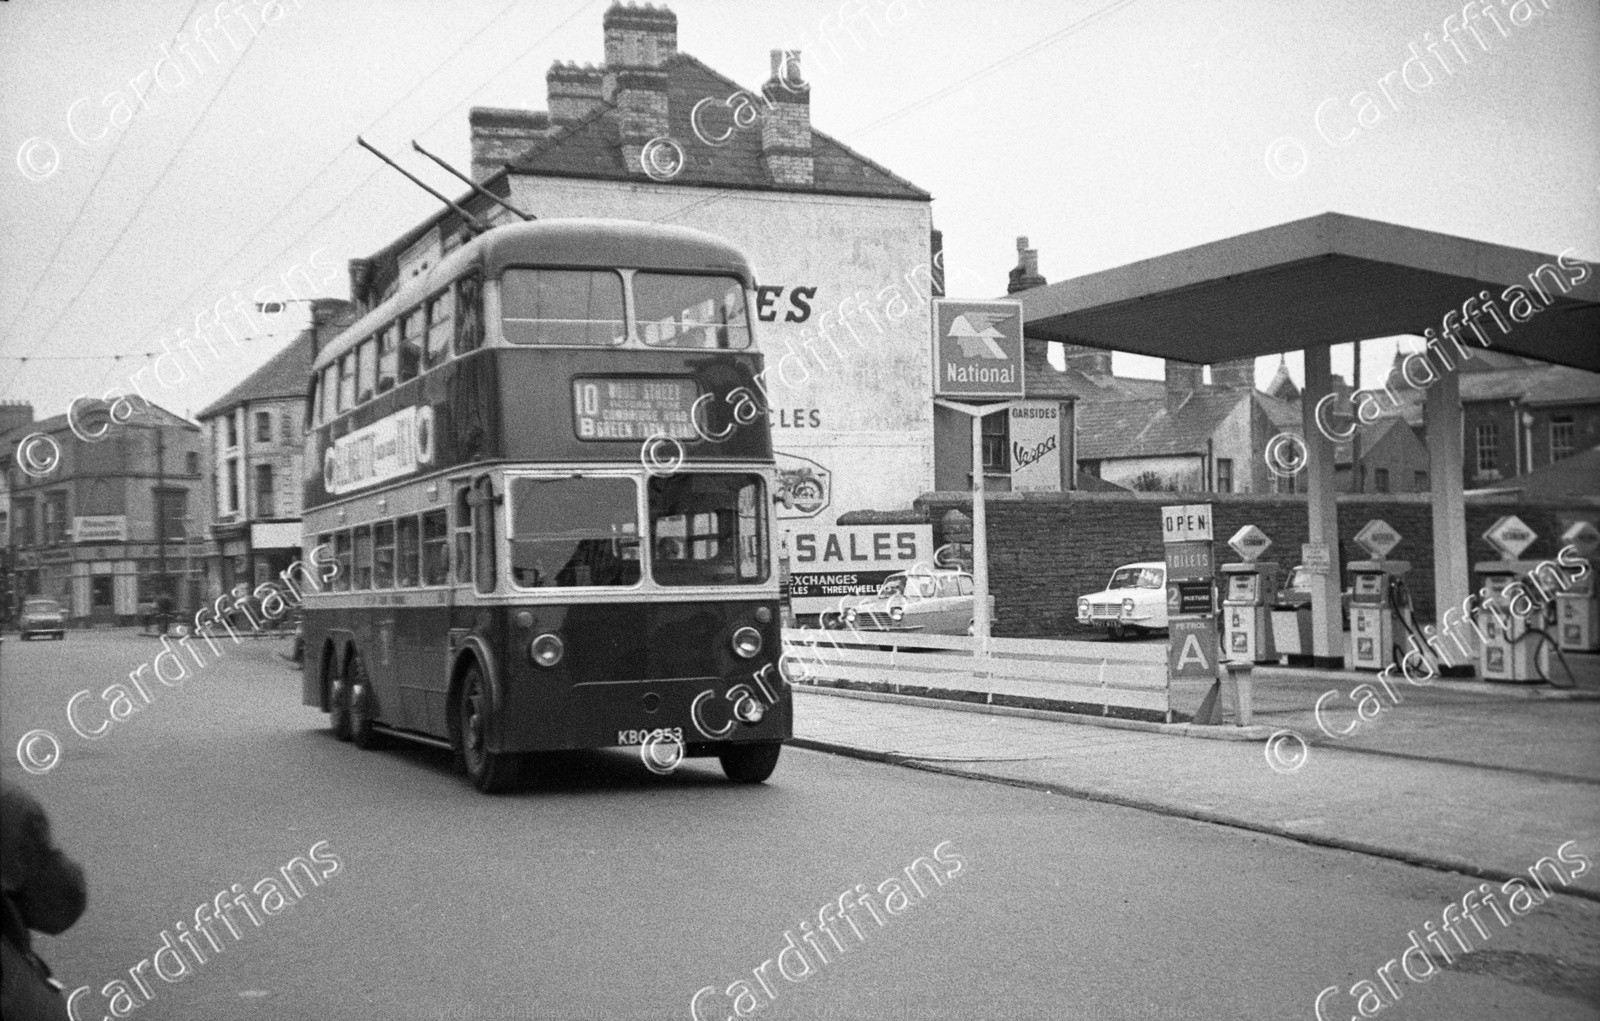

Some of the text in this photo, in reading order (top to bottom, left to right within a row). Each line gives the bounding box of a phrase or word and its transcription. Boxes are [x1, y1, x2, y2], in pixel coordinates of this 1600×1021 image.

[947, 362, 1015, 383] National
[573, 383, 599, 416] 10
[580, 417, 595, 436] B
[1013, 434, 1057, 468] Vespa
[1166, 514, 1206, 532] OPEN
[796, 532, 917, 562] SALES
[1167, 553, 1209, 568] TOILETS
[1175, 622, 1207, 630] PETROL
[1176, 633, 1210, 671] A
[618, 729, 649, 744] KBO
